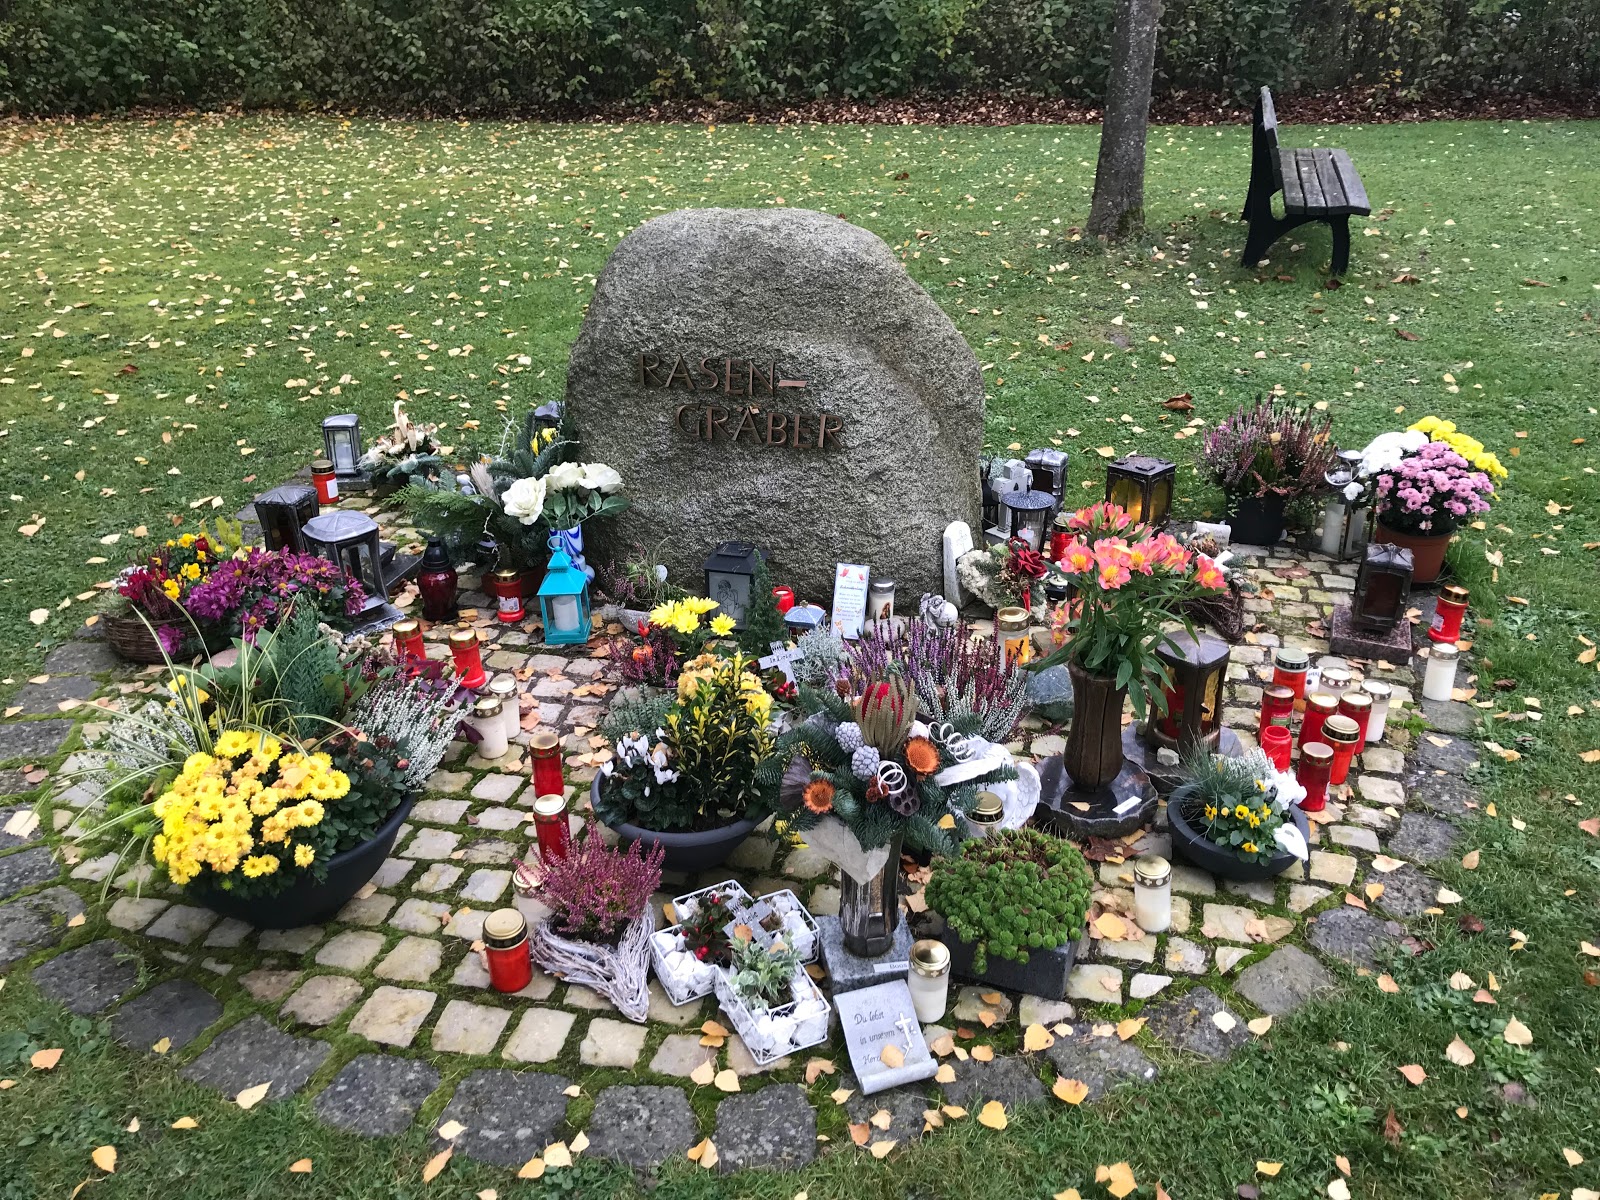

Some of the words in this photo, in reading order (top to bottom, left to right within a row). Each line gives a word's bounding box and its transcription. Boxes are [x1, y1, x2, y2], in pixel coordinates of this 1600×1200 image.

[638, 352, 808, 396] RASEN-
[675, 403, 844, 449] GRÄBER
[854, 1013, 867, 1025] Du
[870, 1010, 885, 1022] lebst
[859, 1036, 867, 1045] in
